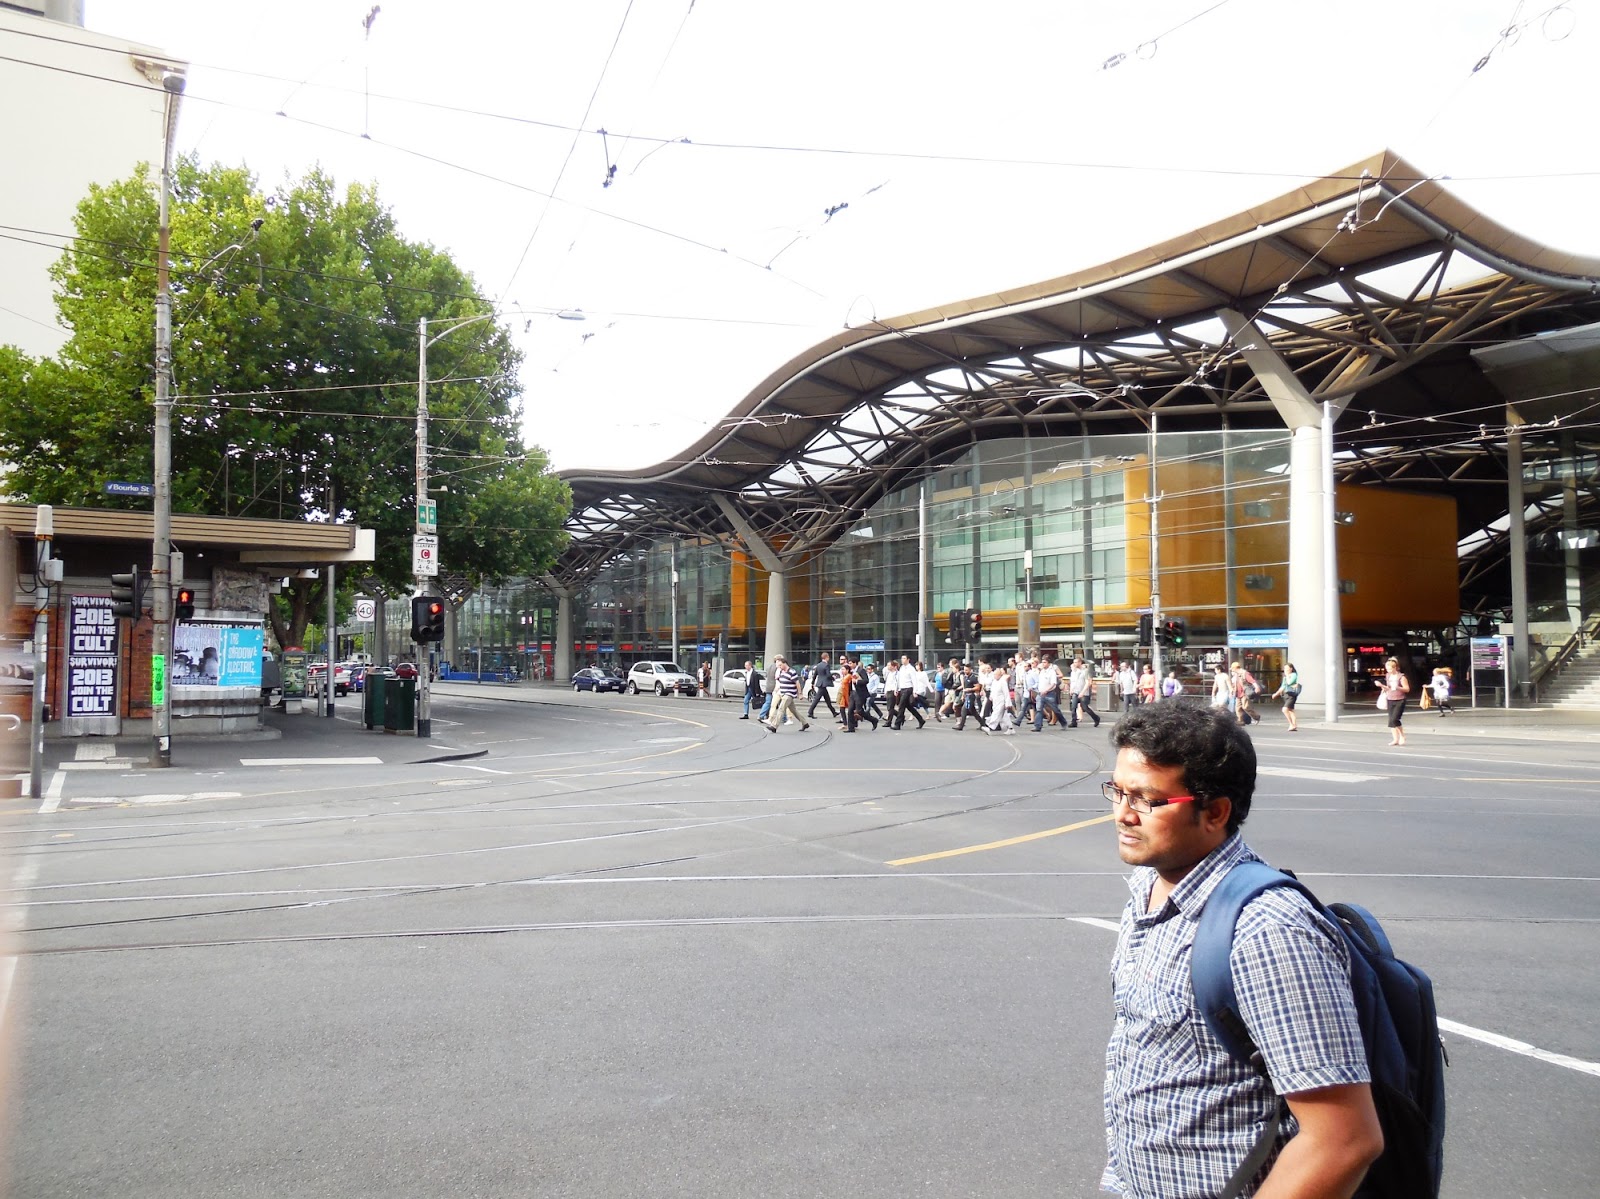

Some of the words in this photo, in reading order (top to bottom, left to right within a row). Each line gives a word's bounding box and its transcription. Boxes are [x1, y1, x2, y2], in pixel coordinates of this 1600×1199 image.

[113, 483, 139, 492] Bourke
[141, 485, 150, 493] St
[359, 606, 371, 615] 40
[75, 608, 115, 625] 2013
[73, 625, 97, 635] JOIN
[97, 626, 116, 635] THE
[74, 635, 114, 651] CULT
[70, 657, 118, 668] SURVIVOR!
[1158, 653, 1196, 662] OUTHERN
[72, 668, 113, 685] 2013
[71, 686, 95, 695] JOIN
[95, 686, 114, 695] THE
[72, 696, 112, 712] CULT
